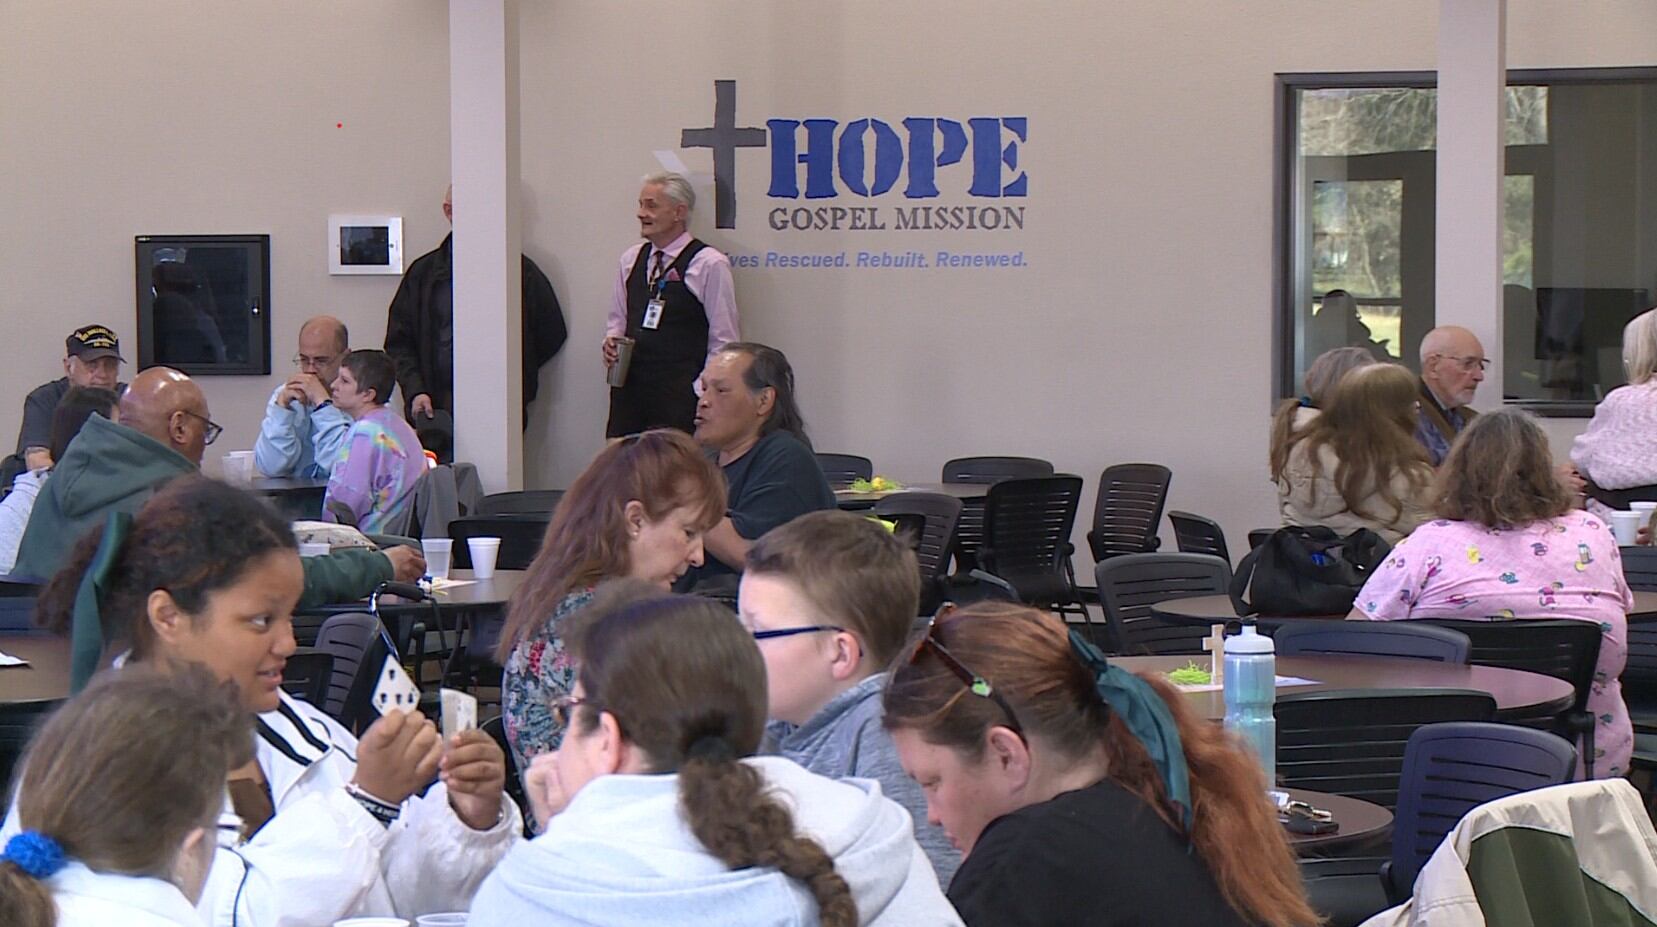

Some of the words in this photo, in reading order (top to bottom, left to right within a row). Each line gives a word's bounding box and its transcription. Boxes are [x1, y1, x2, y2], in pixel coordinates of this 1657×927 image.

[766, 117, 1027, 198] HOPE
[768, 206, 886, 230] GOSPEL
[895, 206, 1025, 230] MISSION
[725, 252, 759, 268] ves
[765, 251, 850, 267] Rescued.
[856, 251, 928, 268] Rebuilt.
[935, 251, 1027, 267] Renewed.
